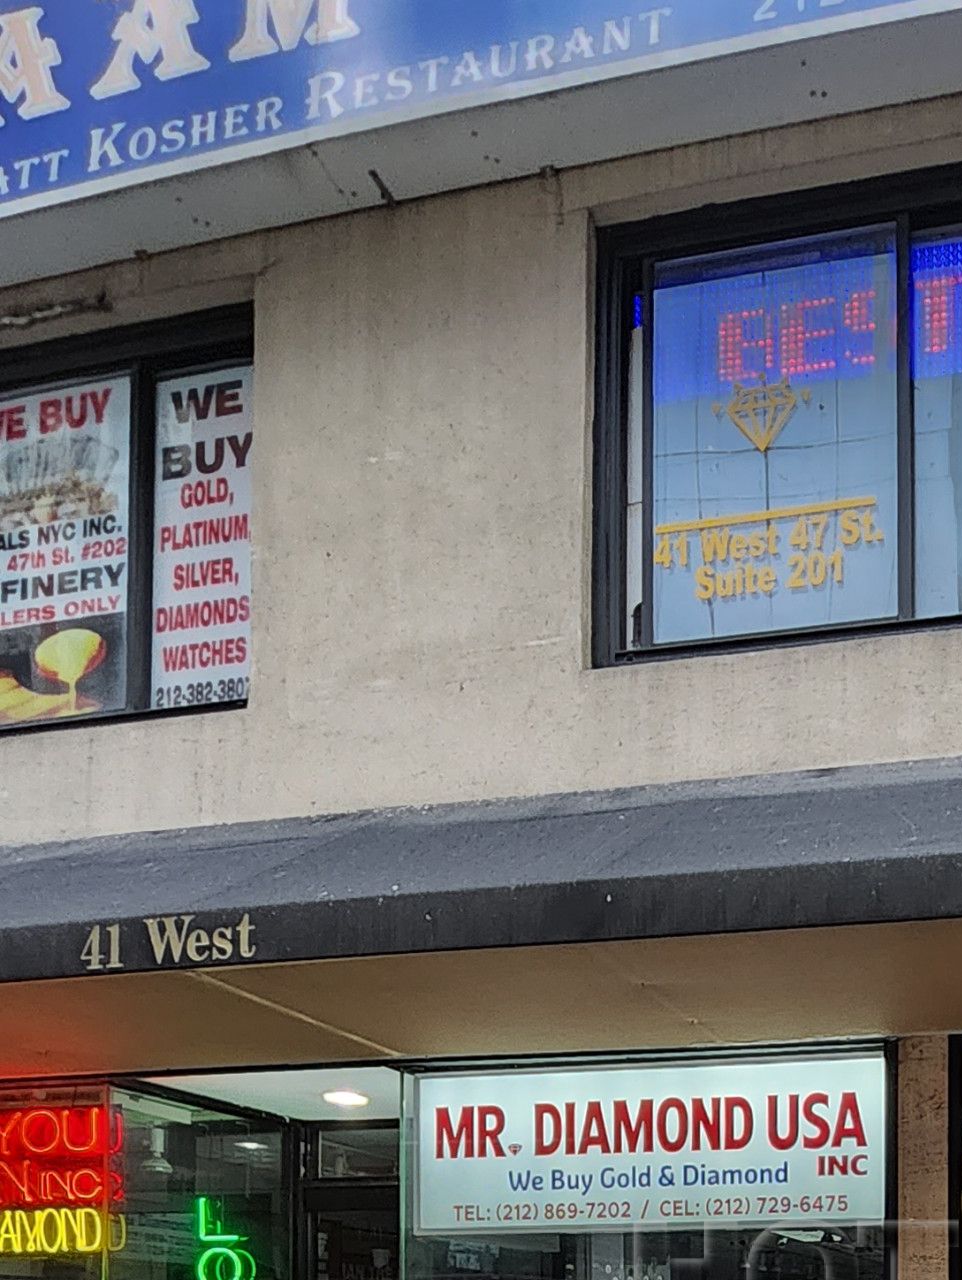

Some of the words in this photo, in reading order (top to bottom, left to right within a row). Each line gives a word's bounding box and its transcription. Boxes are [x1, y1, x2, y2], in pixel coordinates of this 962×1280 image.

[40, 388, 112, 435] BUY
[171, 379, 243, 423] WE
[162, 431, 254, 481] BUY
[180, 477, 234, 509] GOLD,
[37, 522, 76, 545] NYC
[82, 514, 122, 538] INC.
[654, 533, 690, 569] 41
[700, 524, 780, 564] West
[788, 513, 828, 550] 47
[839, 508, 884, 546] St.
[7, 549, 46, 571] 47th
[81, 536, 128, 560] #202
[0, 562, 126, 603] FINERY
[173, 557, 239, 591] SILVER,
[694, 561, 777, 600] Suite
[785, 549, 845, 590] 201
[64, 594, 121, 616] ONLY
[163, 636, 247, 672] WATCHES
[79, 923, 125, 970] 41
[143, 912, 257, 965] West
[533, 1095, 754, 1157] DIAMOND
[767, 1091, 868, 1151] USA
[508, 1169, 545, 1192] We
[551, 1167, 594, 1196] Buy
[600, 1164, 652, 1189] Gold
[657, 1164, 676, 1187] &
[683, 1160, 788, 1186] Diamond
[816, 1154, 868, 1177] INC
[452, 1204, 492, 1222] TEL:
[495, 1202, 539, 1221] (212)
[543, 1200, 632, 1219] 869-7202
[640, 1199, 650, 1219] /
[659, 1199, 701, 1217] CEL:
[705, 1197, 750, 1216] (212)
[756, 1194, 849, 1215] 729-6475
